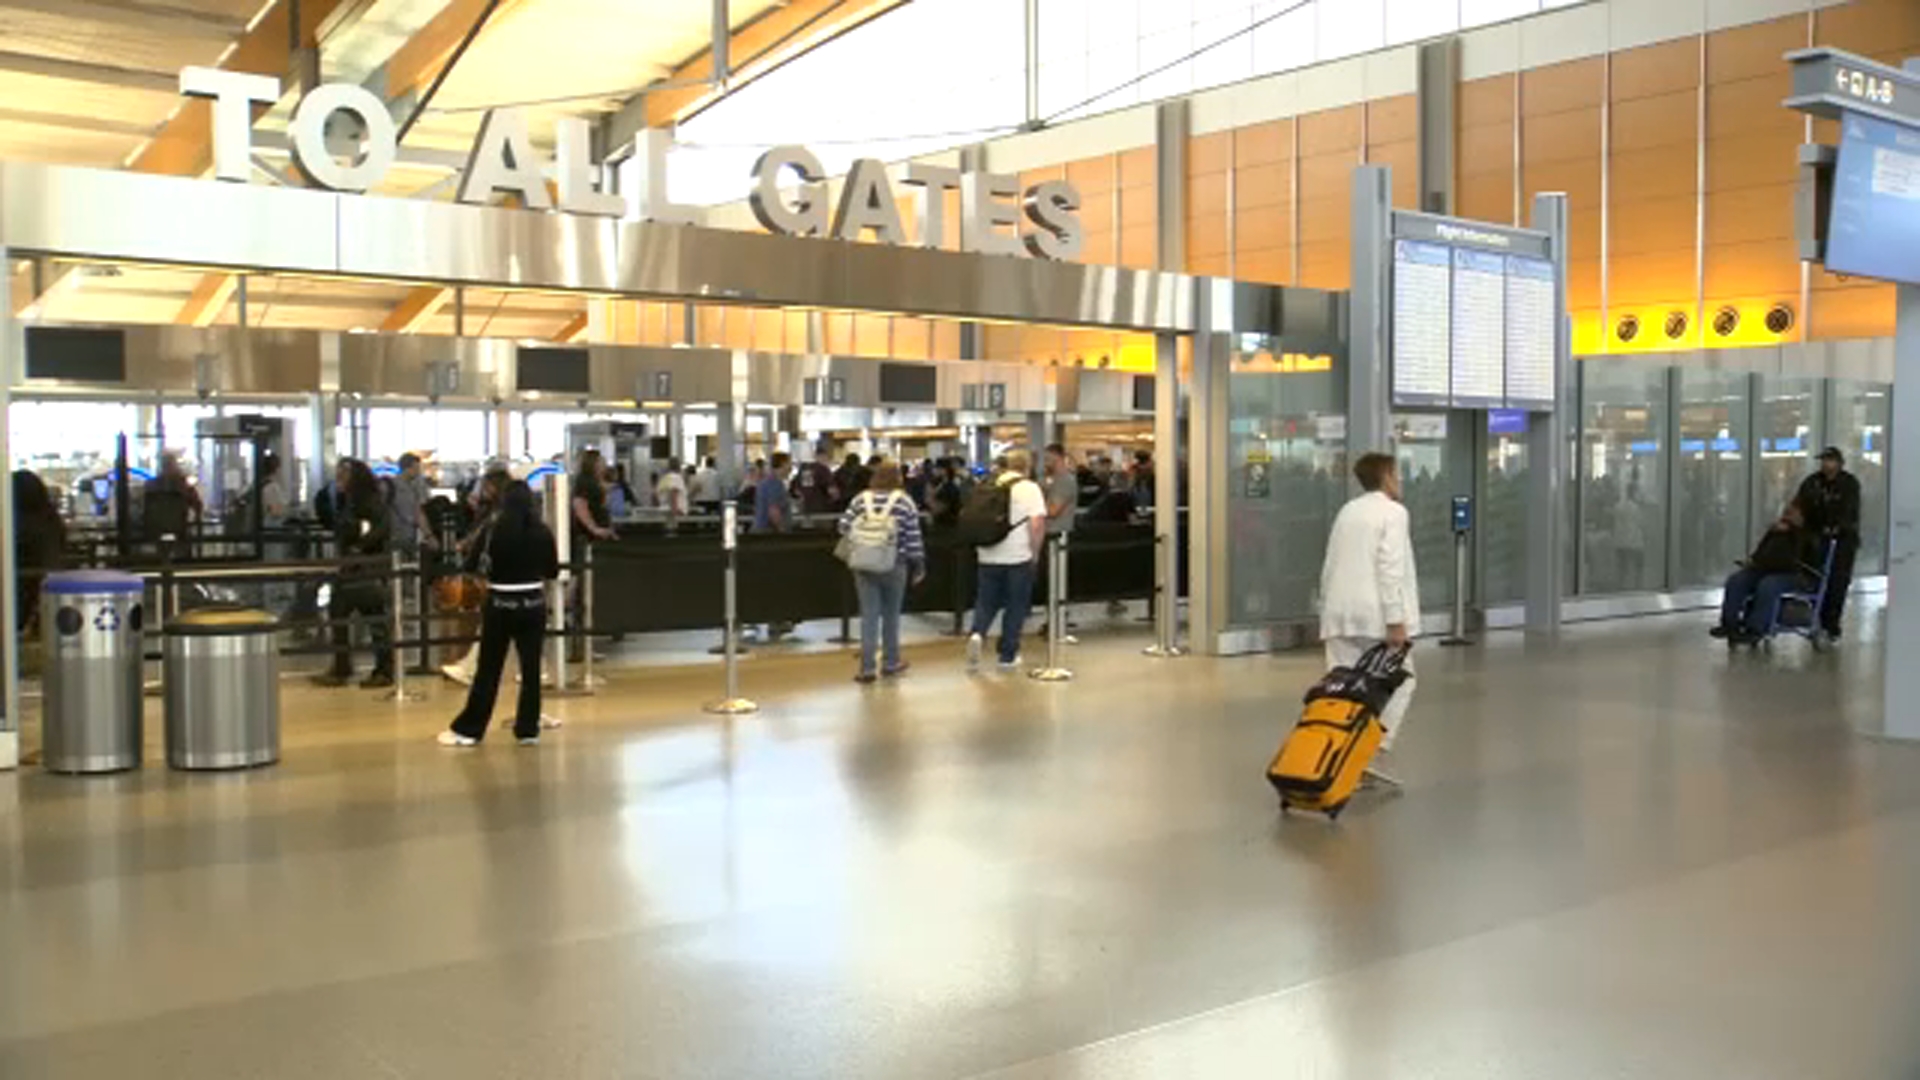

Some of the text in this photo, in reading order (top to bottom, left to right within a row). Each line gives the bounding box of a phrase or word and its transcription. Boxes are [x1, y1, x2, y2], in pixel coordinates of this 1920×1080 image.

[179, 66, 1081, 261] TO ALL GATES
